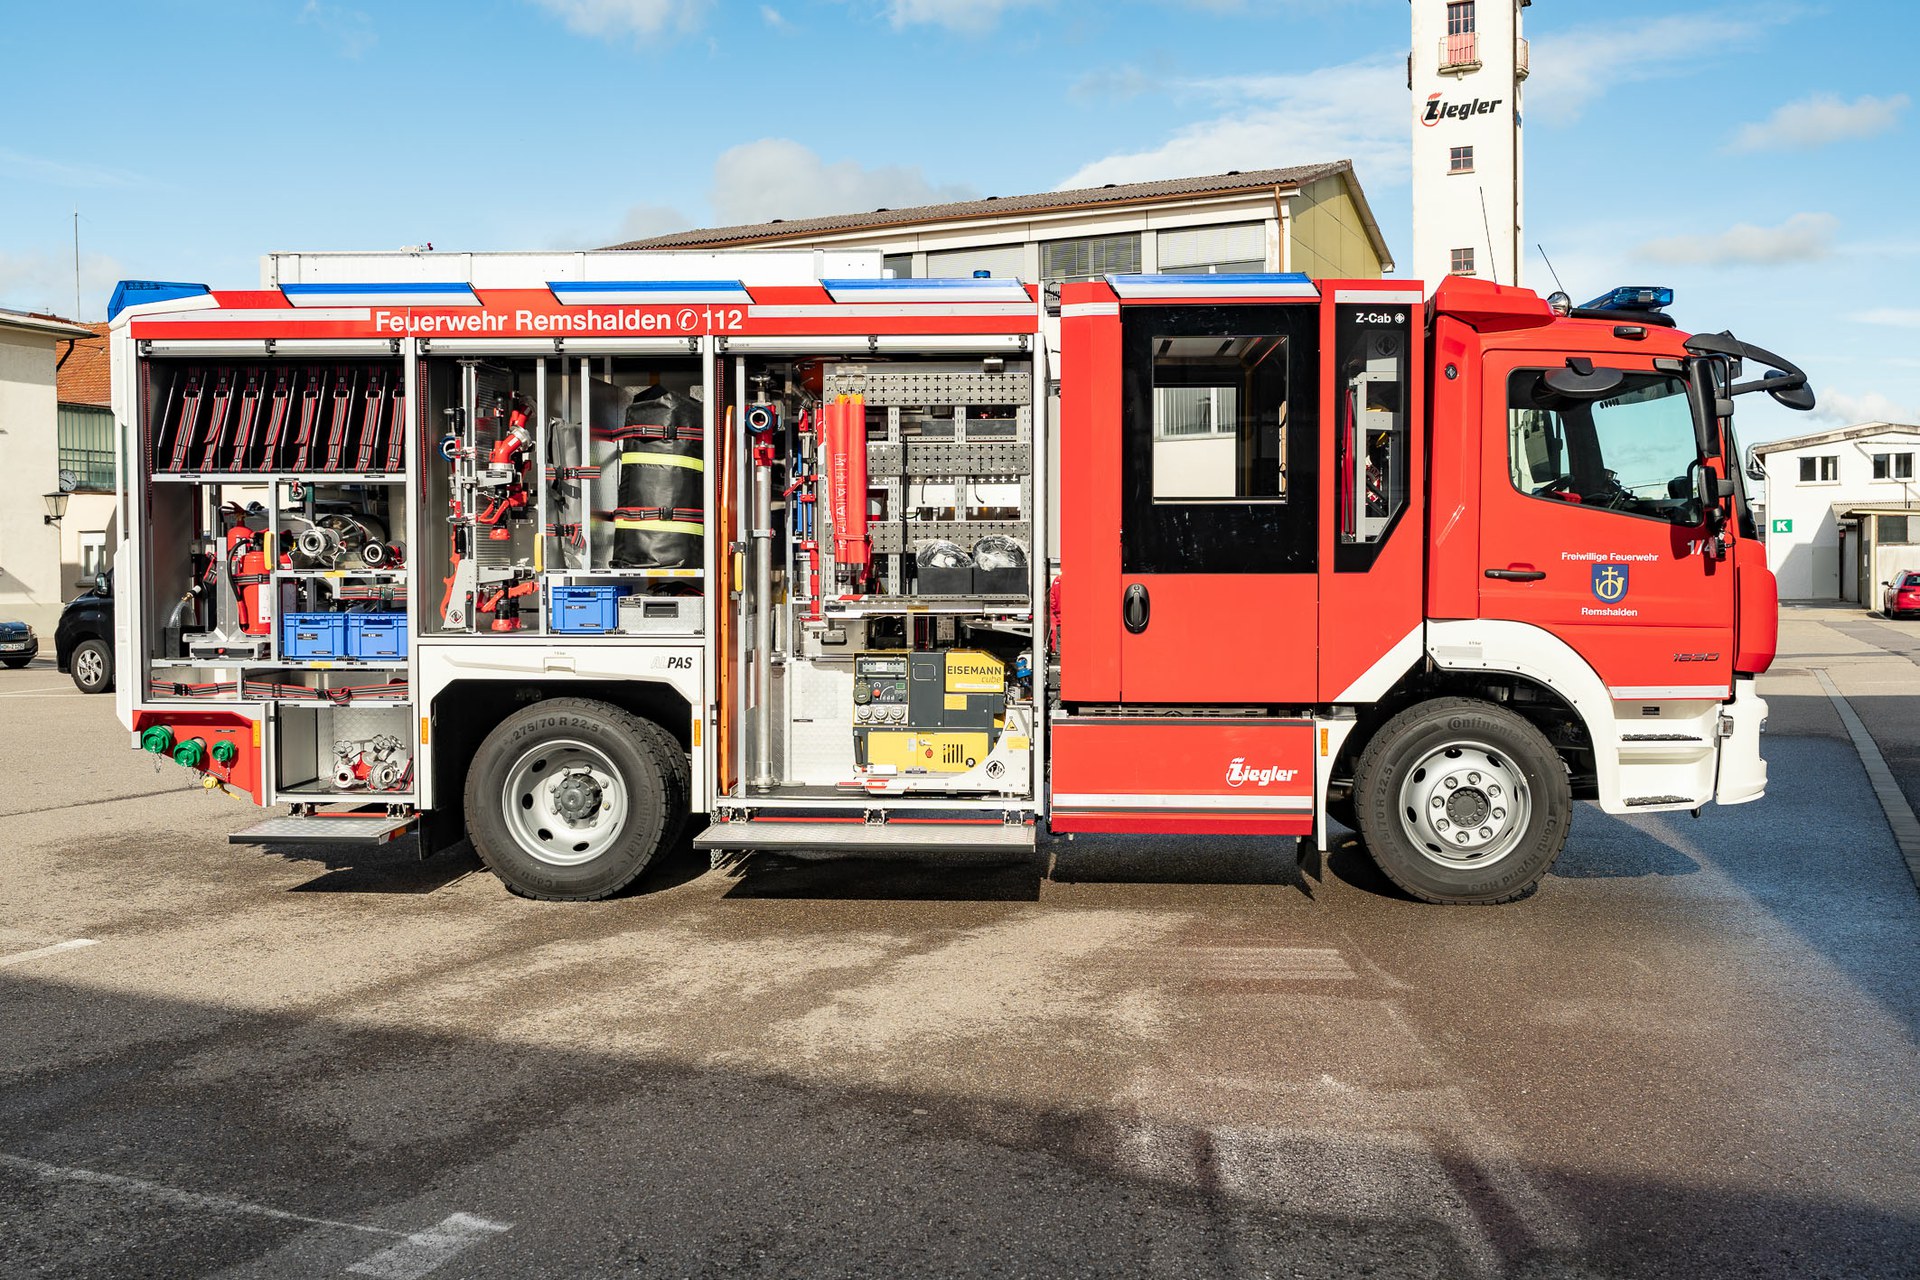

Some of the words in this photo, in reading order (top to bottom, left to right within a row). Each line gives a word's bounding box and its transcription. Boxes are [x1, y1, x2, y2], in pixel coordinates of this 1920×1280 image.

[1423, 97, 1503, 122] Ziegler
[376, 311, 508, 332] Feuerwehr
[515, 309, 671, 331] Remshalden
[702, 309, 743, 330] 112
[1355, 312, 1392, 324] Z-Cab
[1776, 520, 1789, 532] K
[1561, 552, 1608, 562] Freiwillige
[1609, 552, 1659, 562] Feuerwehr
[1581, 607, 1638, 617] Remshalden
[947, 665, 1002, 675] EISEMANN
[981, 675, 1002, 684] cube
[512, 717, 556, 741] 275/70
[559, 717, 568, 727] R
[571, 718, 600, 733] 22.5
[1227, 761, 1299, 787] Ziegler
